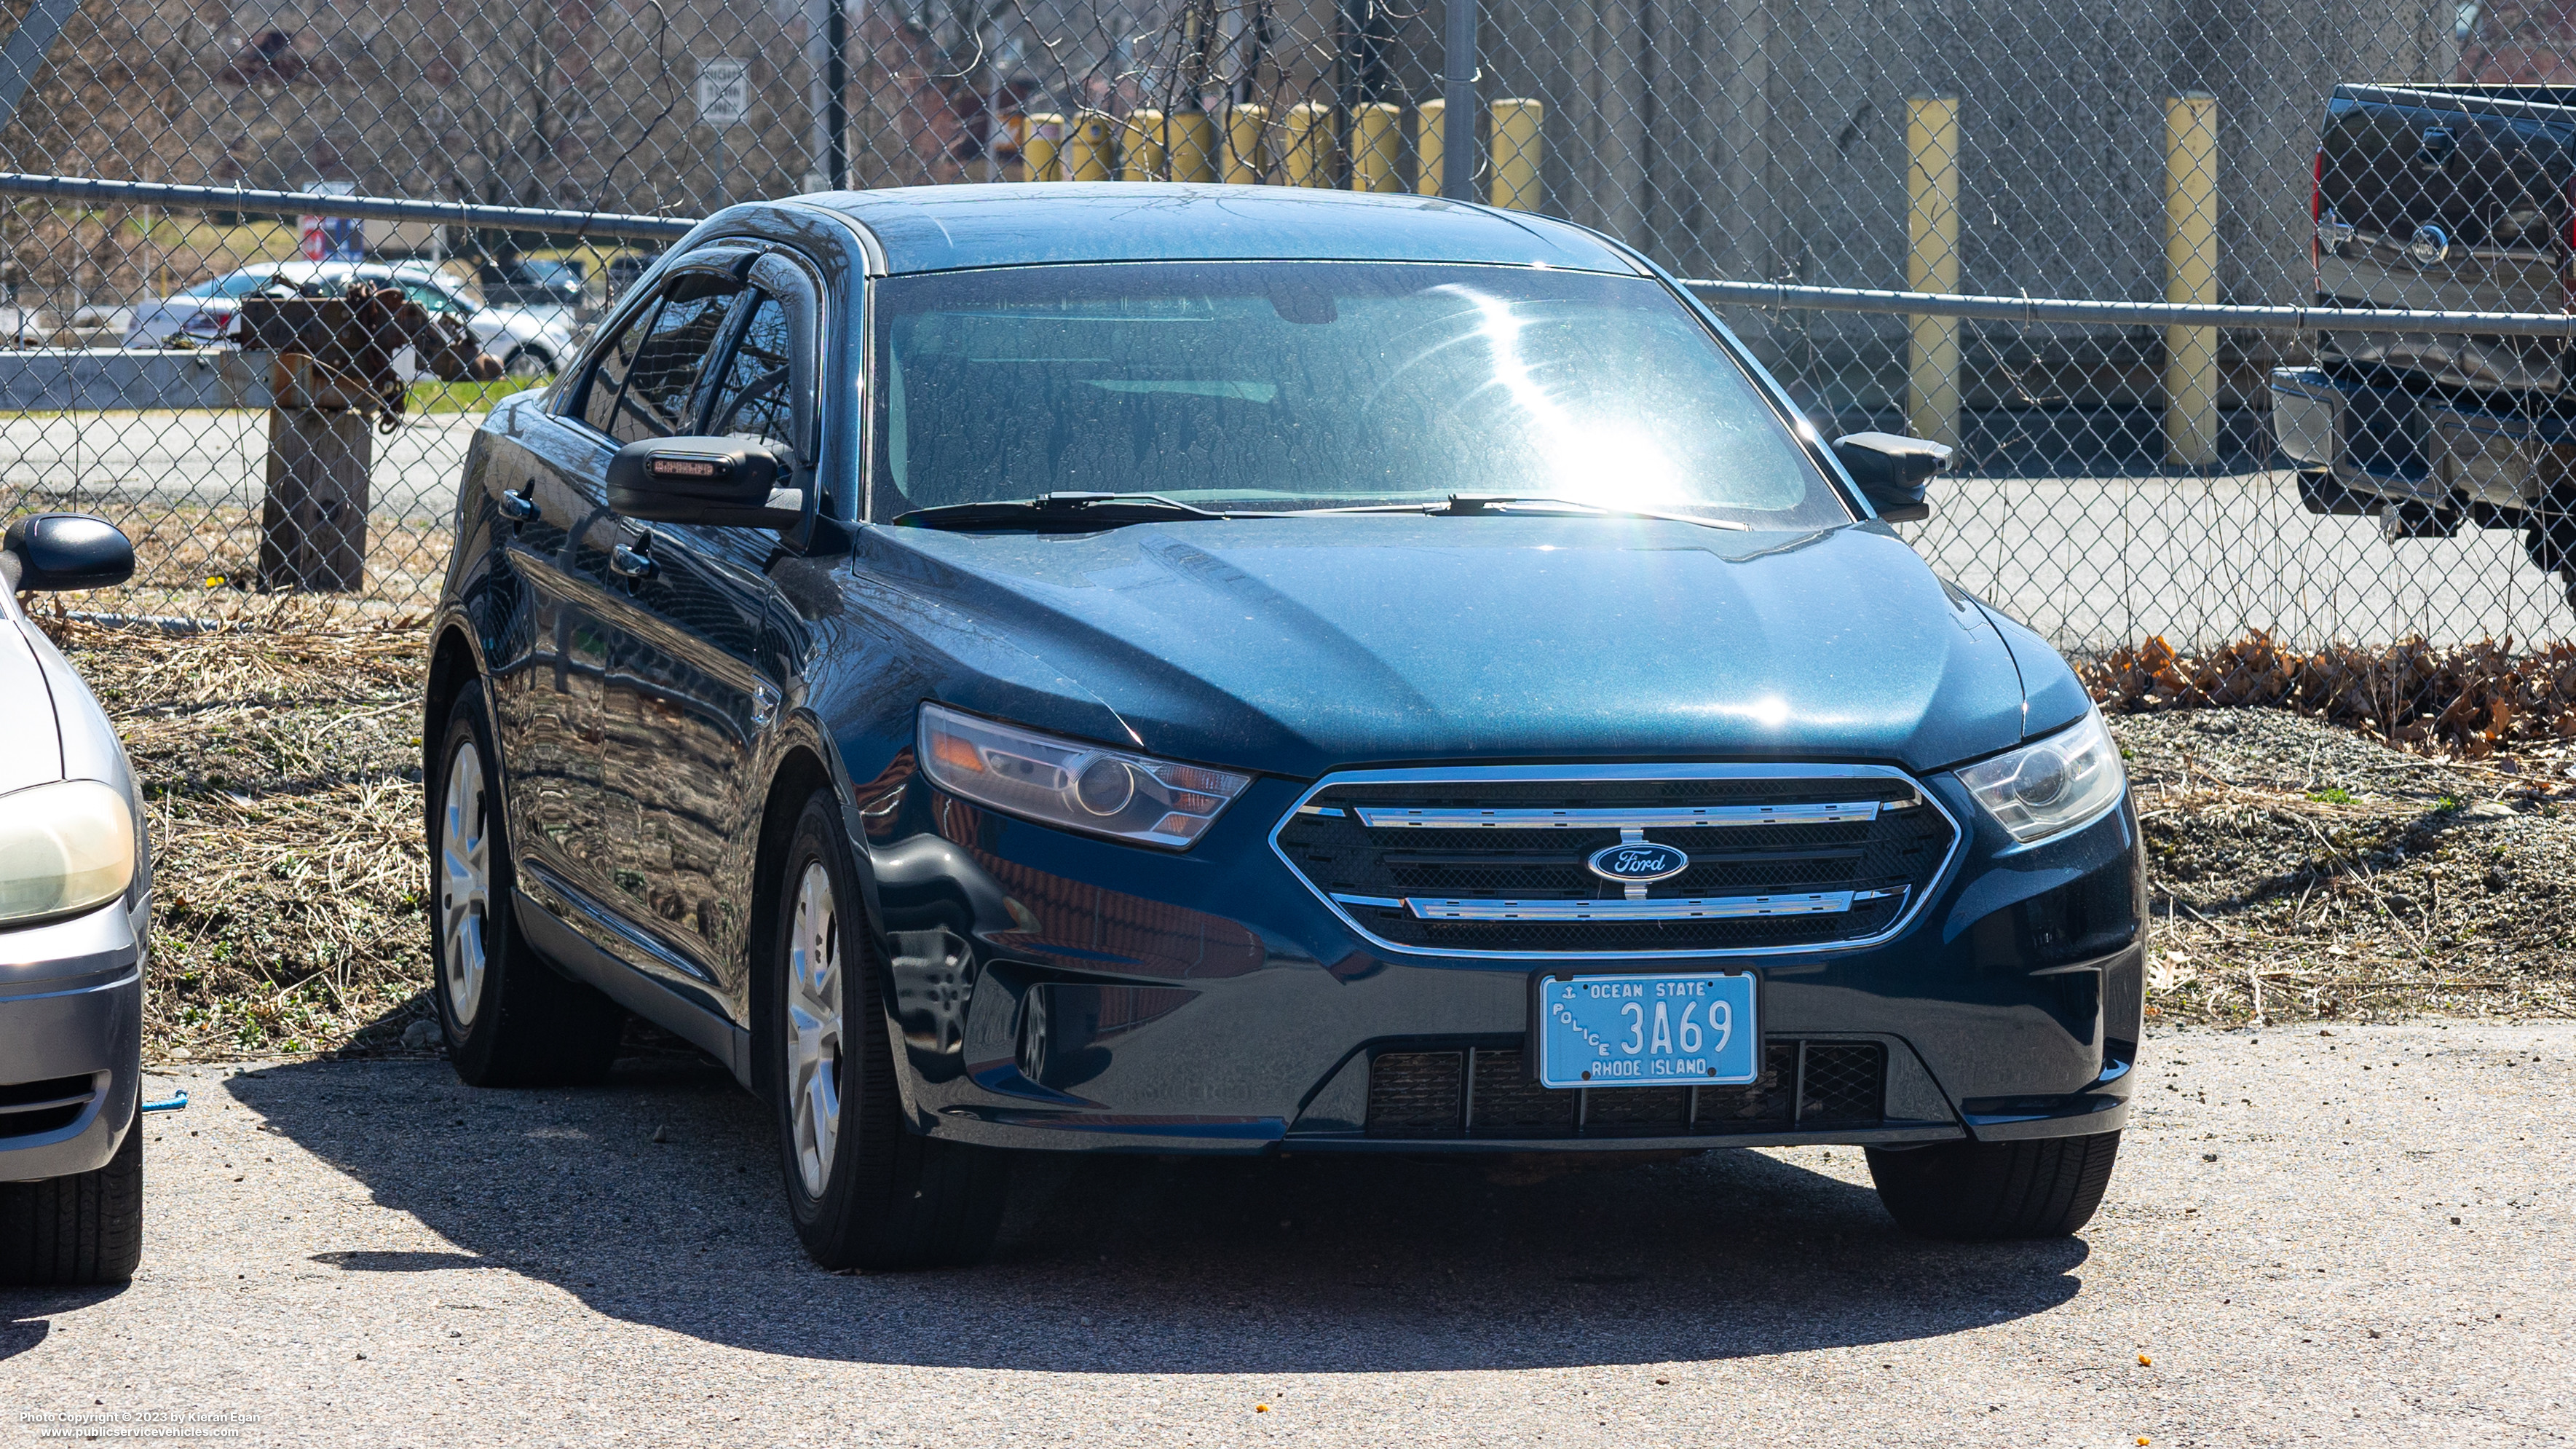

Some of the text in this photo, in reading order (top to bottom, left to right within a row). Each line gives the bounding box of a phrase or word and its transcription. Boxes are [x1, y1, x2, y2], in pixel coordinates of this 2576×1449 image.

[2414, 232, 2435, 256] Ford
[1614, 850, 1666, 872] Ford
[1590, 982, 1706, 999] OCEAN STATE
[1552, 1003, 1611, 1056] POLICE
[1621, 1000, 1733, 1054] 3A69
[1592, 1058, 1707, 1077] RHODE ISLAND
